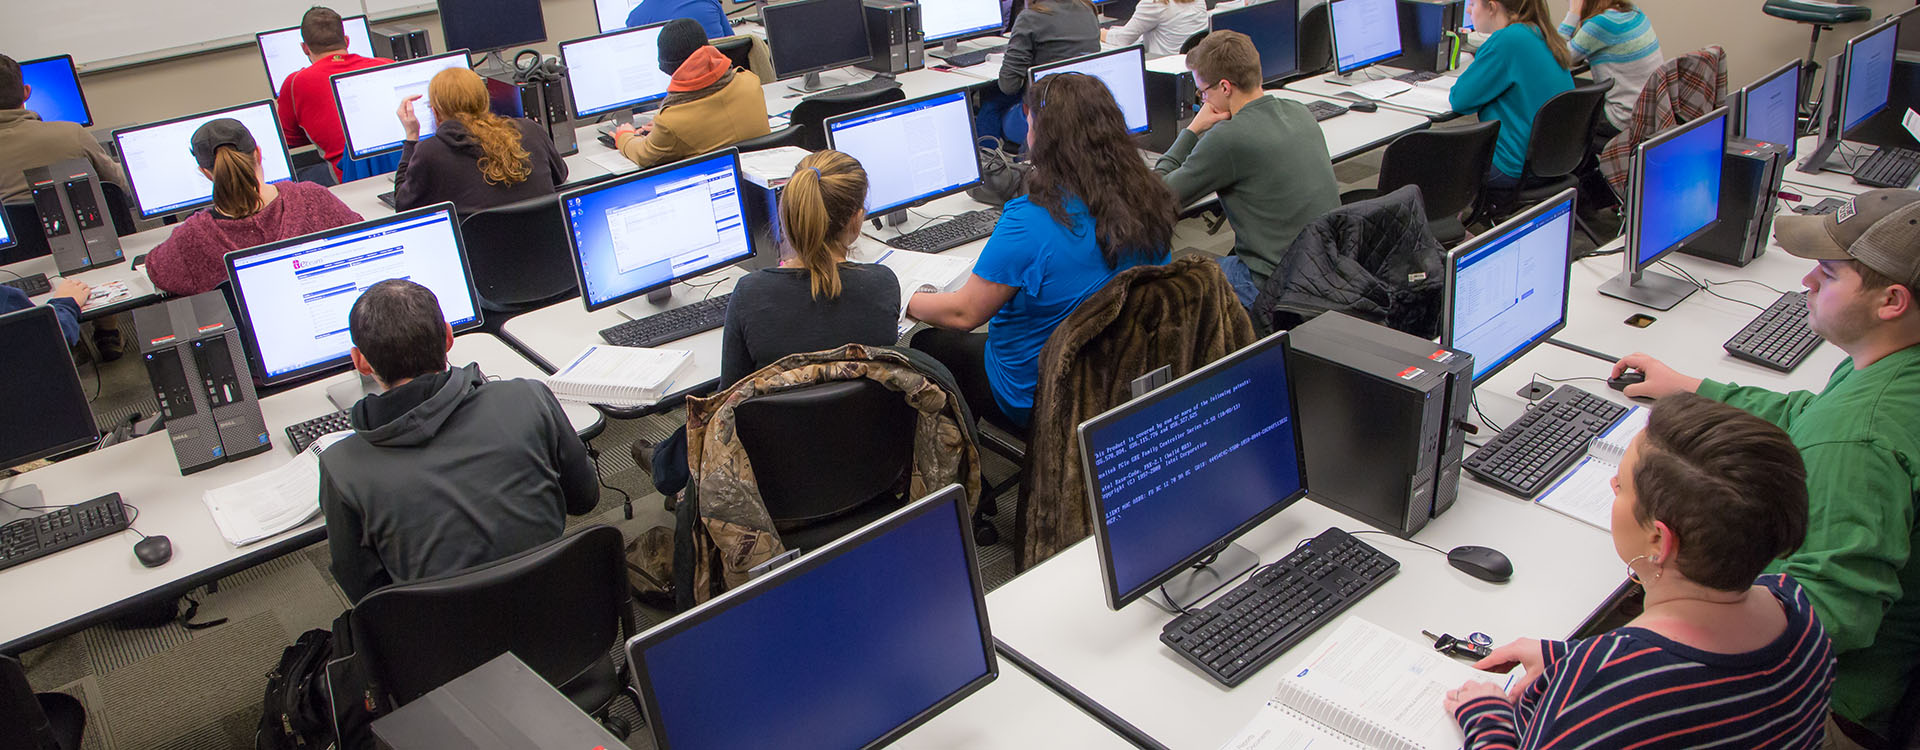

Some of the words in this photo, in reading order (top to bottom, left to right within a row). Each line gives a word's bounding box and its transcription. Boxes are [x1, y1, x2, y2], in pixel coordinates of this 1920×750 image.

[172, 433, 188, 441] DELL
[1106, 439, 1126, 454] Product
[1135, 425, 1155, 439] covered
[1208, 387, 1232, 404] following
[1097, 465, 1116, 480] ealtek
[1117, 459, 1130, 470] PCIe
[1140, 444, 1159, 459] Family
[1158, 430, 1185, 449] Controller
[1185, 422, 1202, 435] Series
[1101, 482, 1125, 501] opyright
[1164, 455, 1178, 466] Intel
[1178, 439, 1208, 459] Corporation
[1104, 506, 1120, 520] LIENT
